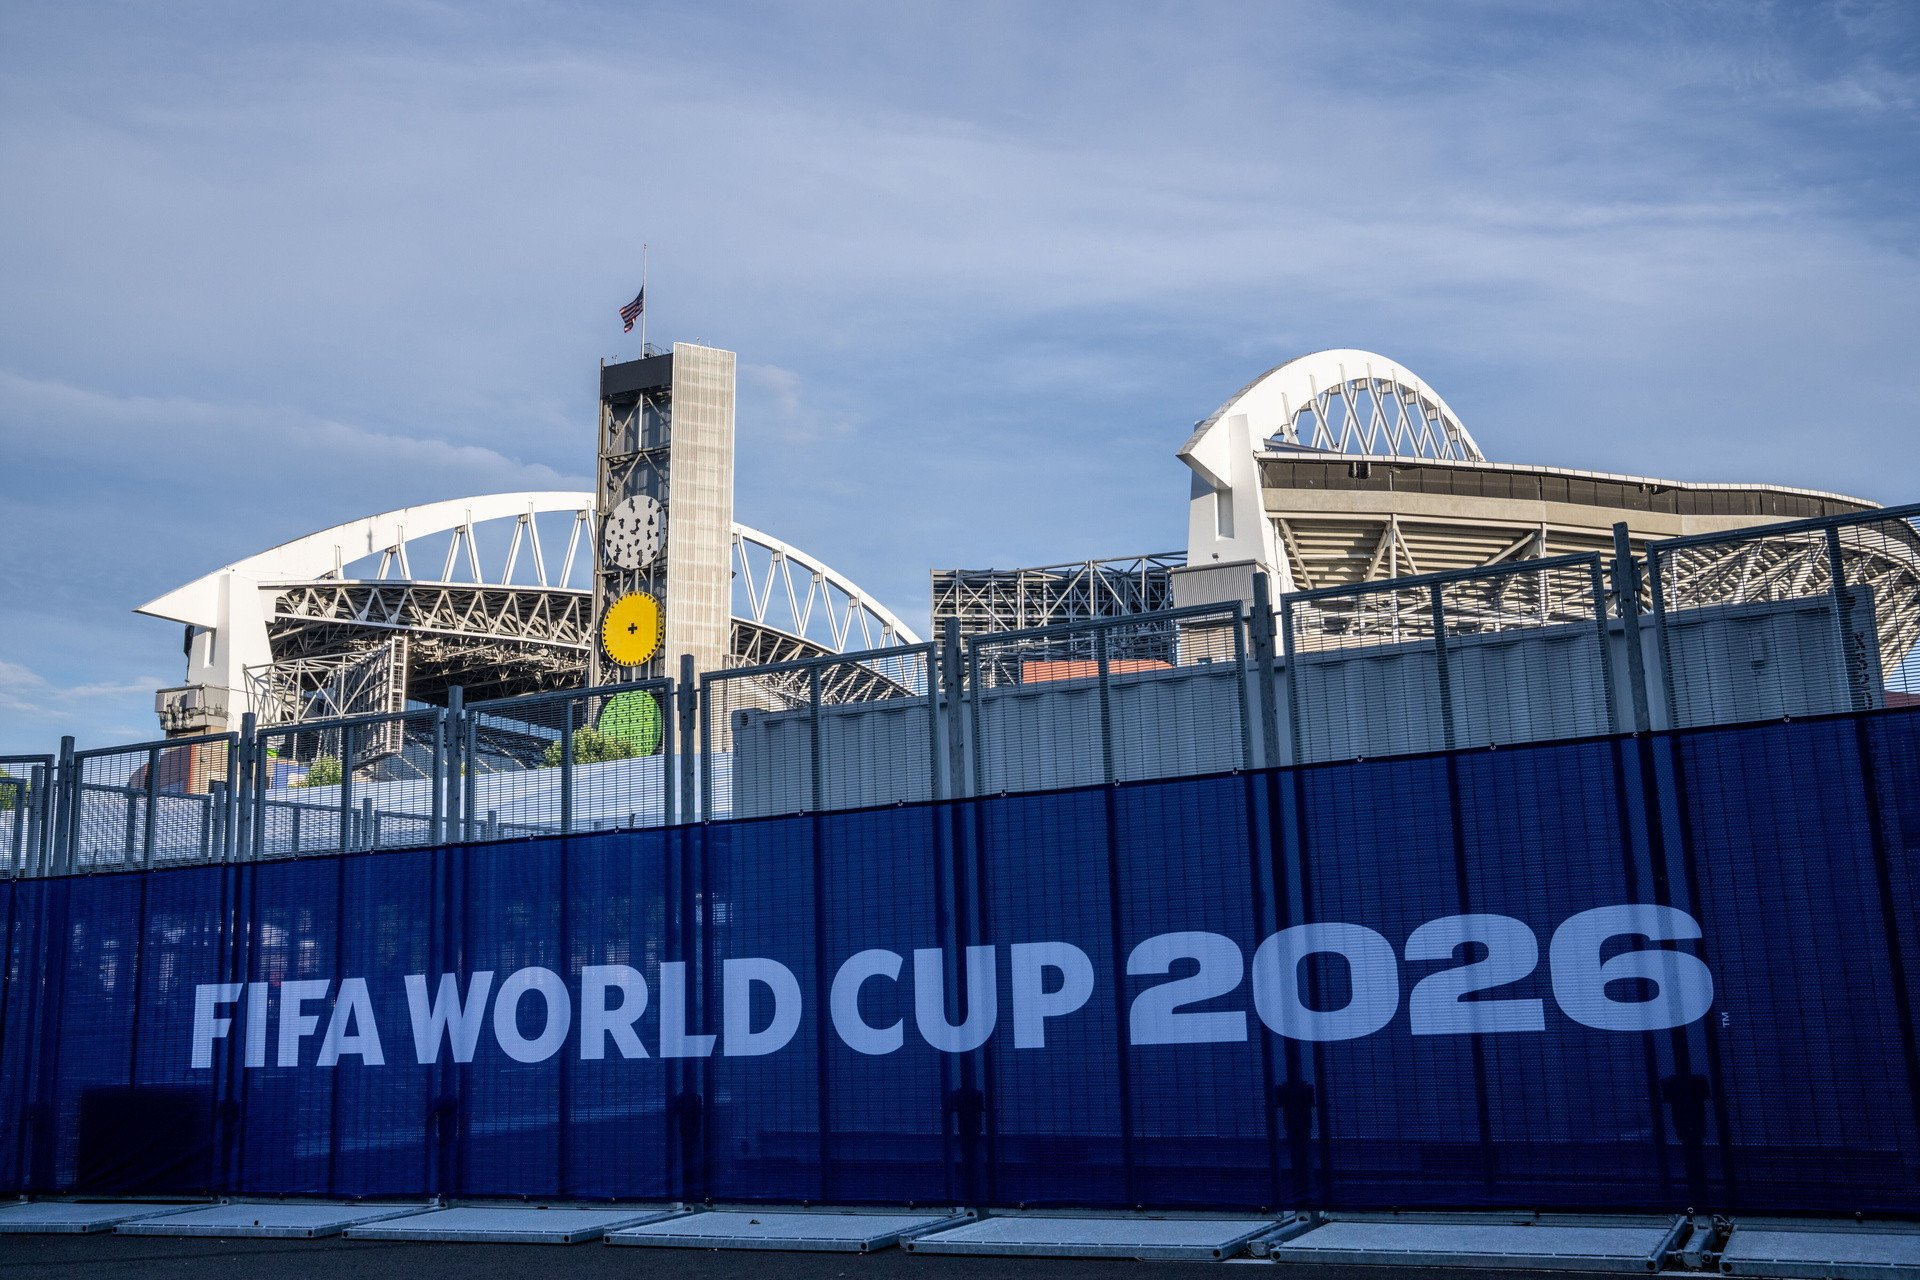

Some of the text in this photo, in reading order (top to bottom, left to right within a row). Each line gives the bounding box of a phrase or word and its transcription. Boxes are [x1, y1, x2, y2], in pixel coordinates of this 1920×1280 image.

[191, 904, 1714, 1068] FIFA WORLD CUP 2026
